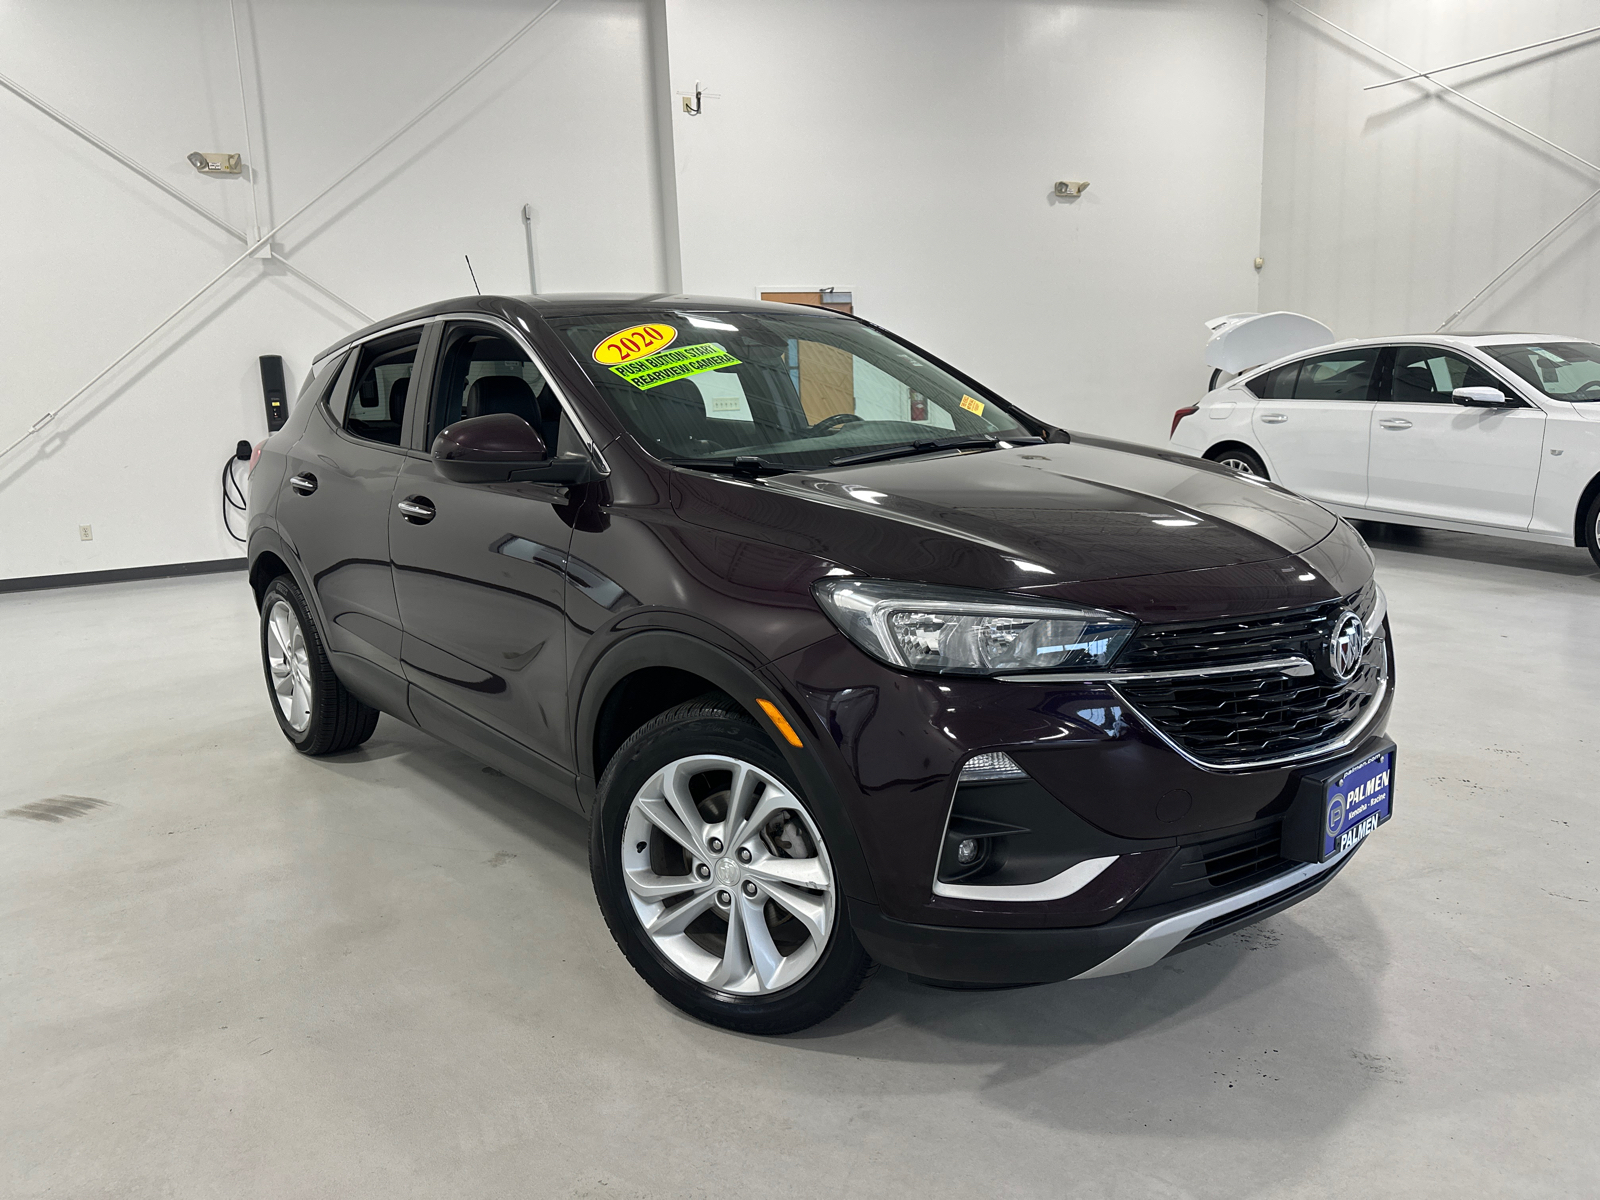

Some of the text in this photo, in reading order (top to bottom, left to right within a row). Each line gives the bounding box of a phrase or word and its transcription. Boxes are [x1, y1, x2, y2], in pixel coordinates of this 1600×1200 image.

[607, 326, 664, 361] 2020
[616, 344, 717, 377] PUSH BUTTON START
[631, 353, 735, 387] REARVIEW CAMERA
[1346, 769, 1390, 810] PALMEN
[1348, 803, 1367, 820] Kenosha
[1370, 792, 1386, 806] Racine
[1340, 813, 1378, 852] PALMEN
